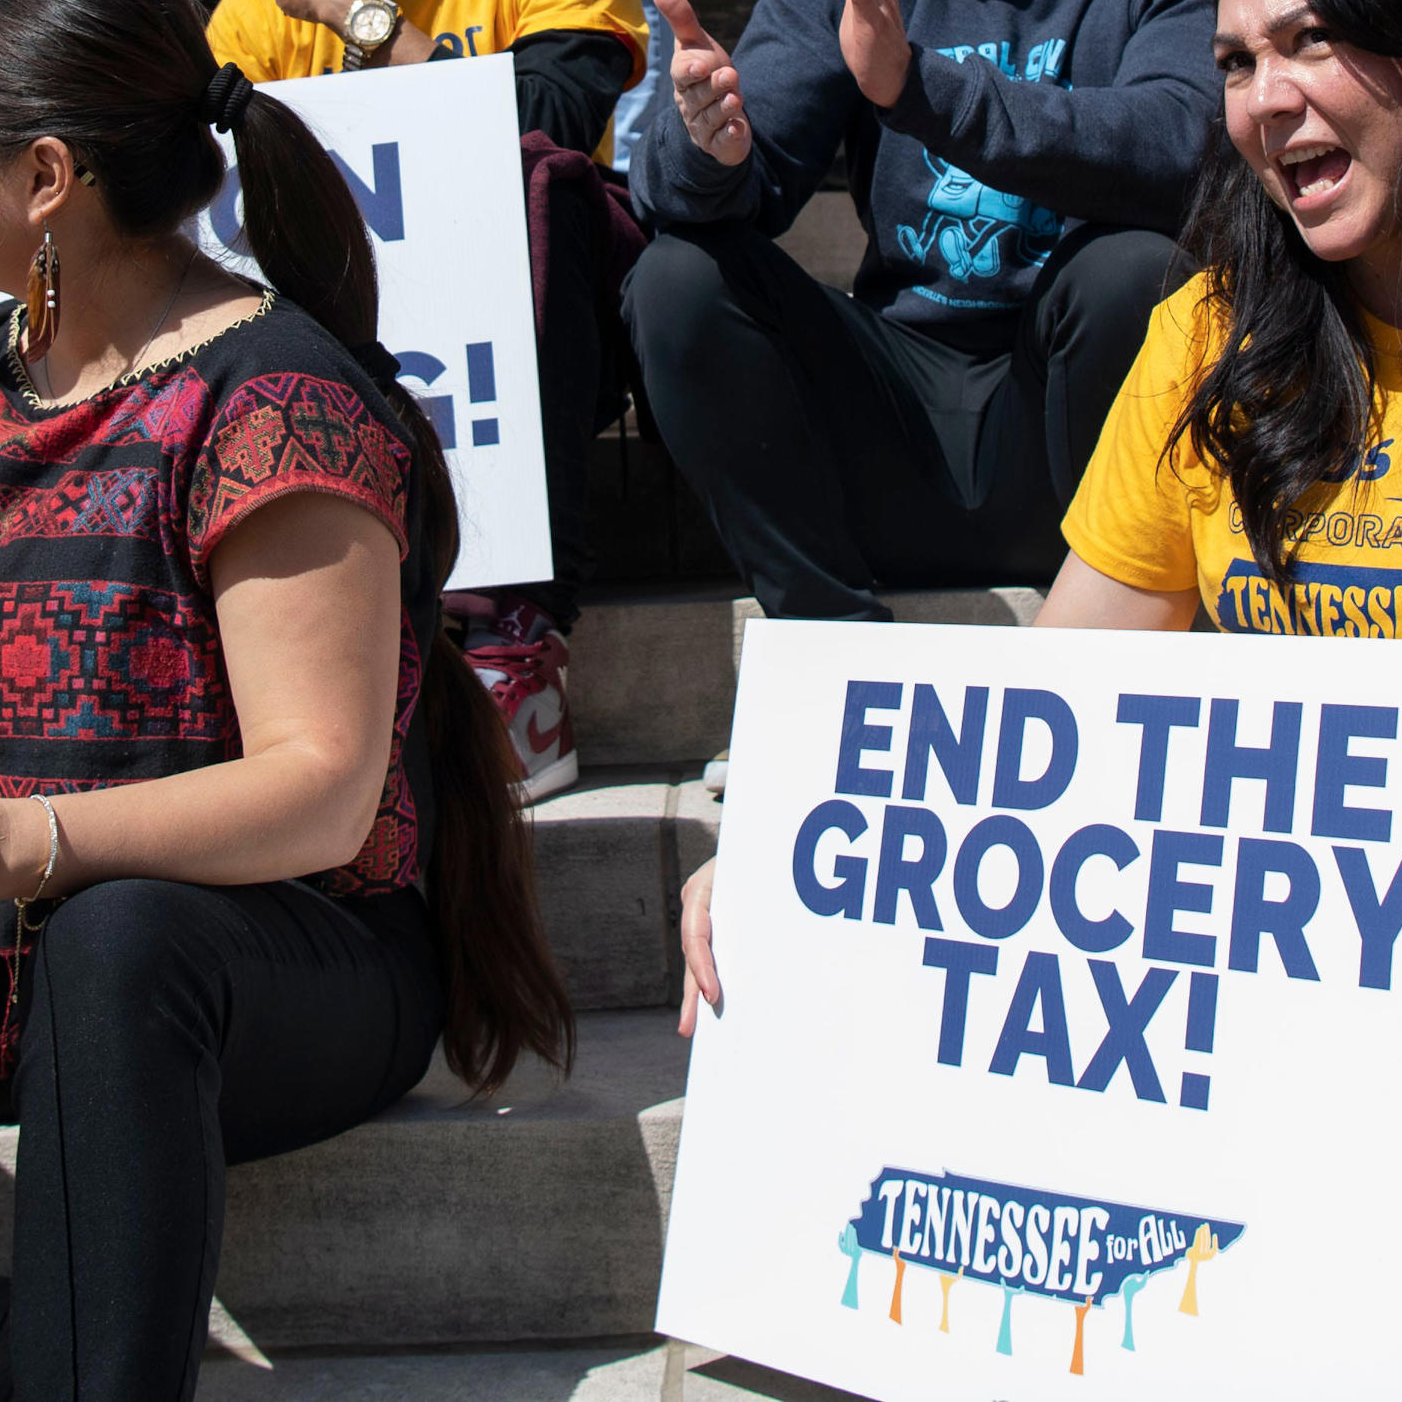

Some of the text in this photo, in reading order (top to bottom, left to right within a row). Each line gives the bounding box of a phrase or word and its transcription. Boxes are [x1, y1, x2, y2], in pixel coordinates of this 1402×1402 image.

[833, 679, 1400, 842] END THE
[922, 936, 1220, 1112] TAX!
[877, 1179, 1186, 1295] TENNESSEE for ALL
